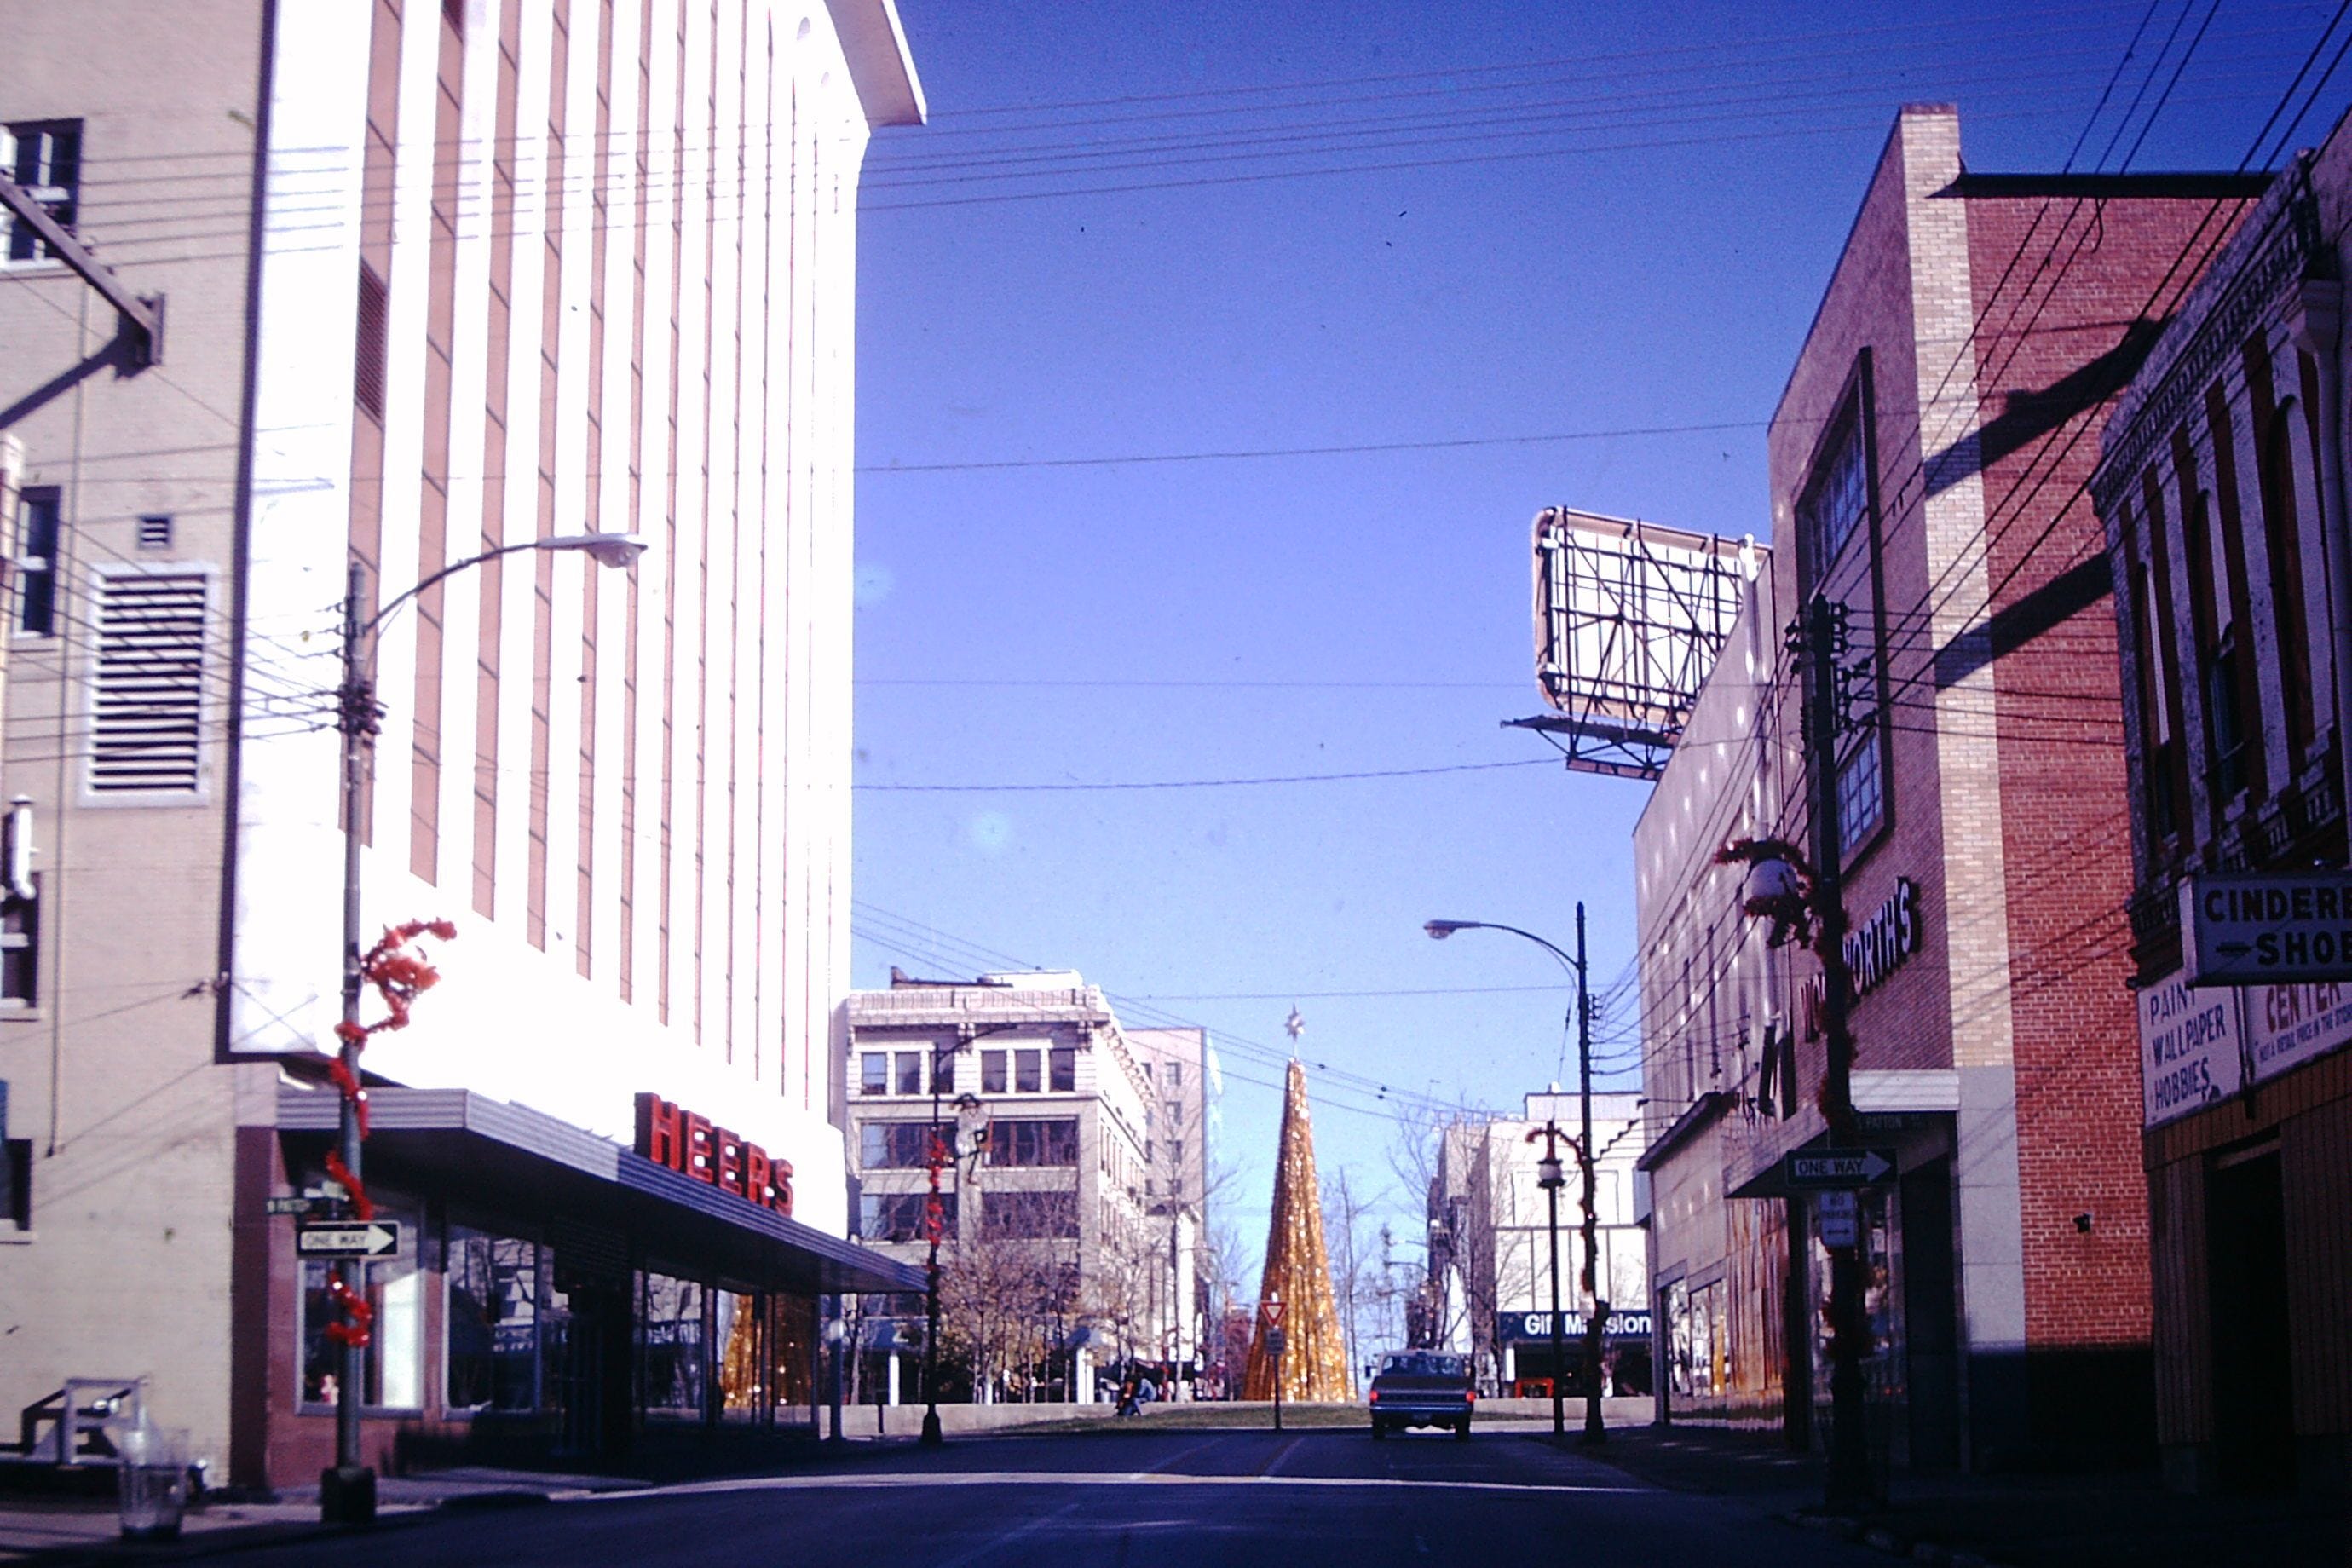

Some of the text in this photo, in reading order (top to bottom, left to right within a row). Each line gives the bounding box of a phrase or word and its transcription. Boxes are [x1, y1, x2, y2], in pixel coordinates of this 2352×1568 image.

[1800, 878, 1913, 1042] WOWORTH'S
[2153, 1003, 2227, 1067] WALLPAPER
[2154, 1056, 2210, 1110] HOBBIES
[634, 1092, 793, 1219] HEERS
[1798, 1157, 1863, 1175] ONE WAY
[306, 1233, 366, 1248] ONE WAY
[1524, 1313, 1652, 1335] Gif Msion
